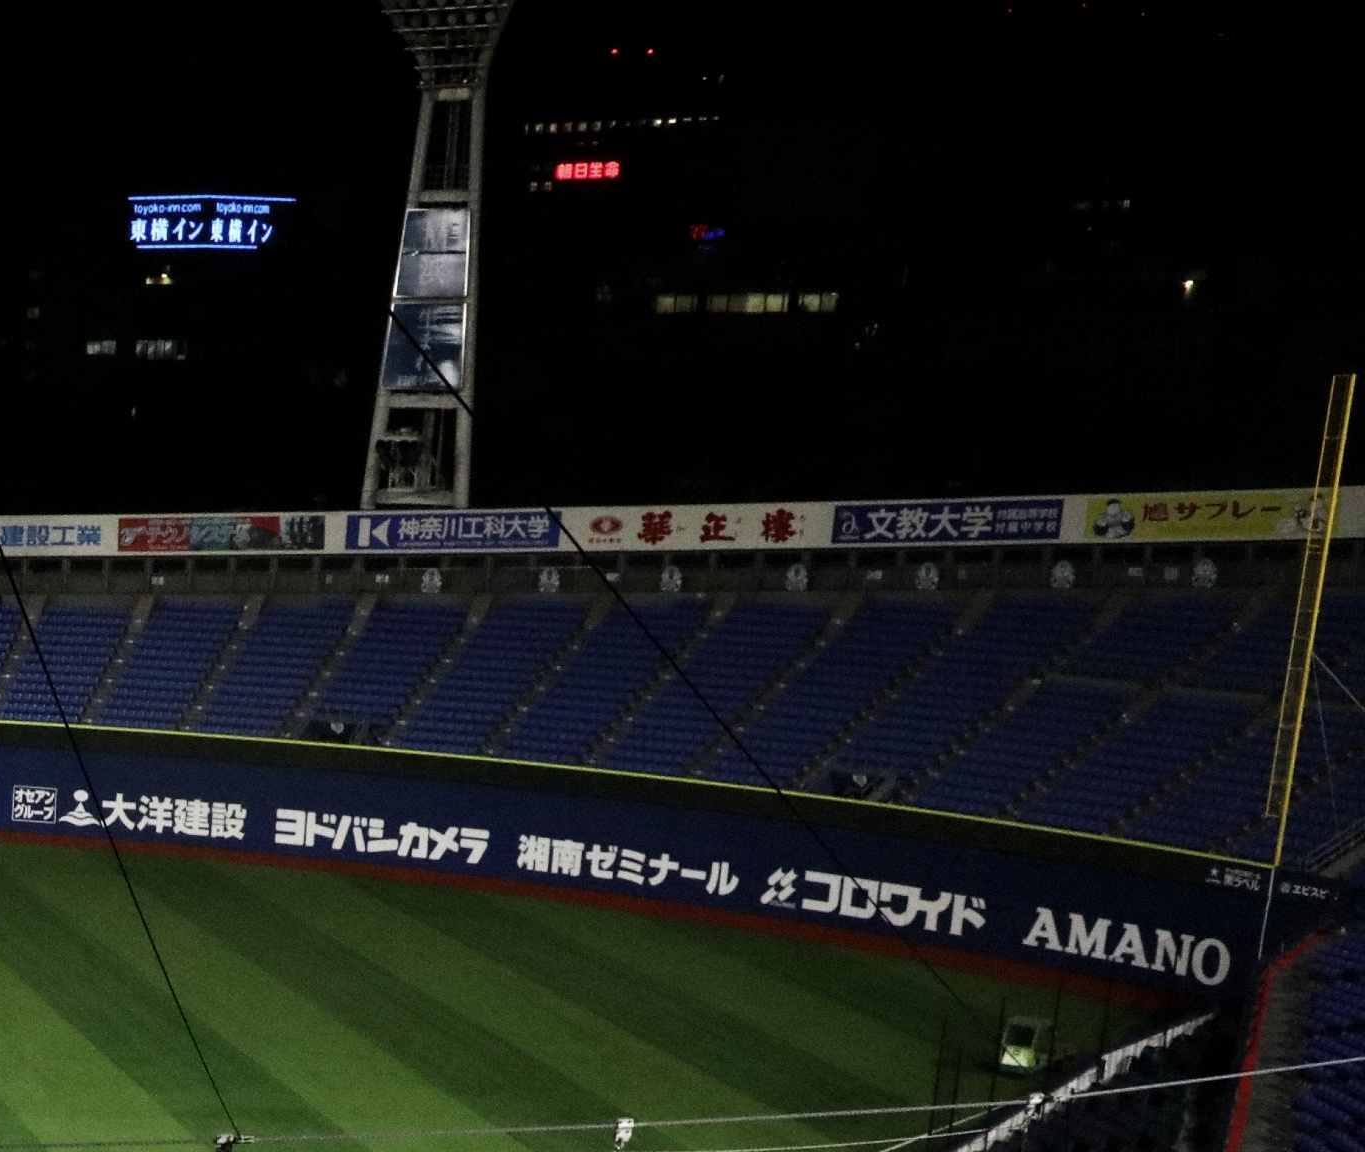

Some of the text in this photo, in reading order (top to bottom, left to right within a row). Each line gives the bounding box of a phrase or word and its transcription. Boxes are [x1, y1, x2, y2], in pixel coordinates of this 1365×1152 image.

[556, 161, 620, 180] 朝日生命
[130, 218, 203, 242] 東横イン
[211, 218, 272, 243] 東横イン
[398, 515, 549, 540] 神奈川工科大学
[864, 506, 994, 540] 文教大学
[15, 789, 54, 803] オセアン
[14, 804, 53, 820] グループ
[101, 793, 247, 840] 大洋建設
[275, 809, 489, 863] ヨドバシカメラ
[518, 834, 739, 895] 湘南ゼミナール
[802, 869, 987, 935] コロワイド
[1023, 907, 1229, 985] AMANO
